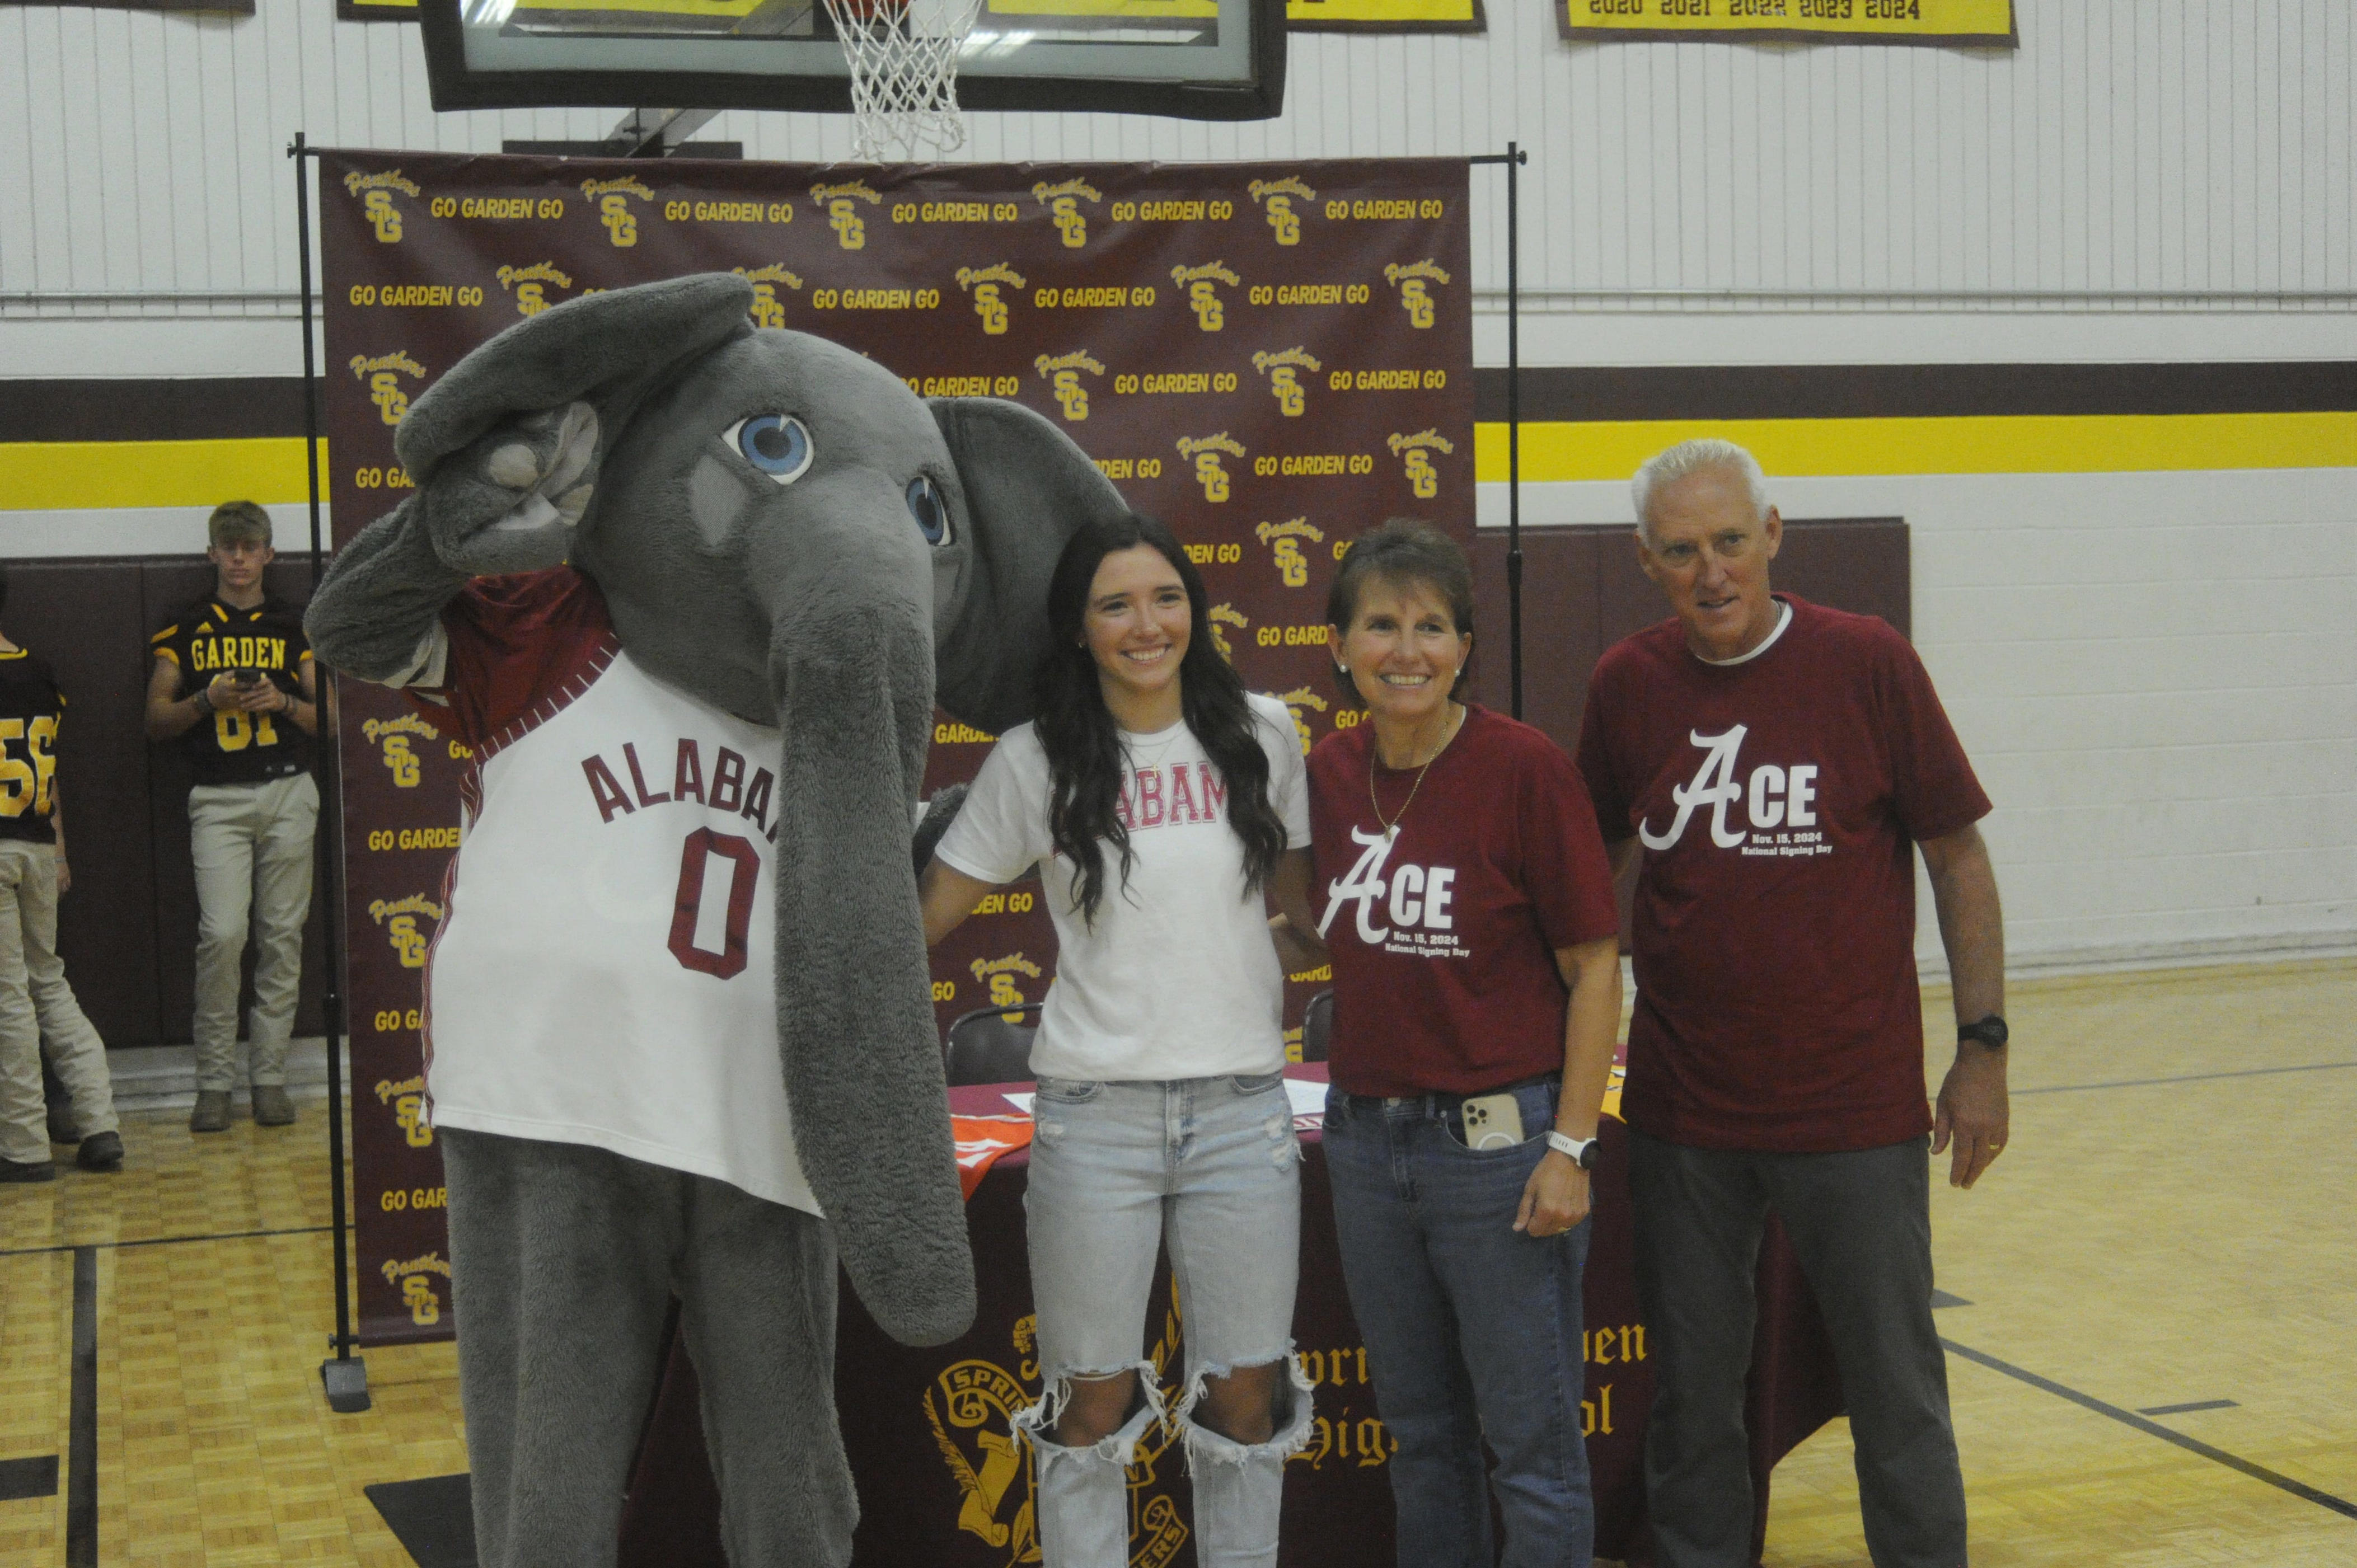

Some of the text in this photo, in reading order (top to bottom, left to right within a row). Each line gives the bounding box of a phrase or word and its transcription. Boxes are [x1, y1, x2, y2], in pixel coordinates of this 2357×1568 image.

[1800, 0, 1853, 19] 2023
[1866, 0, 1920, 20] 2024
[366, 191, 401, 242] SG
[430, 197, 564, 219] GO GARDEN GO
[665, 200, 793, 224] GO GARDEN GO
[892, 202, 1018, 223] GO GARDEN GO
[1112, 201, 1233, 222] GO GARDEN GO
[1325, 199, 1443, 219] GO GARDEN GO
[602, 196, 636, 246] SG
[830, 200, 864, 250] SG
[1054, 198, 1086, 247] SG
[1267, 196, 1300, 245] SG
[349, 285, 484, 307] GO GARDEN GO
[813, 288, 940, 309] GO GARDEN GO
[1035, 287, 1156, 308] GO GARDEN GO
[1249, 284, 1370, 306] GO GARDEN GO
[1402, 280, 1435, 328] SG
[976, 285, 1008, 334] SG
[1191, 282, 1223, 331] SG
[924, 377, 990, 397] GARDEN
[994, 376, 1019, 396] GO
[1114, 373, 1238, 394] GO GARDEN GO
[1329, 369, 1446, 390] GO GARDEN GO
[372, 374, 407, 424] SG
[1055, 372, 1088, 420] SG
[1273, 368, 1304, 416] SG
[1093, 458, 1162, 479] DEN GO
[1254, 454, 1374, 476] GO GARDEN GO
[1406, 450, 1436, 497] SG
[355, 467, 383, 489] GO
[1197, 454, 1229, 502] SG
[1217, 543, 1241, 564] GO
[1333, 541, 1353, 560] G
[1275, 538, 1307, 586] SG
[1257, 626, 1328, 646] GO GARD
[191, 637, 285, 670] GARDEN
[1336, 710, 1358, 729] GO
[384, 736, 420, 786] SG
[581, 738, 779, 844] ALABA
[1115, 760, 1230, 833] ABAM
[1639, 724, 1817, 851] ACE
[368, 828, 462, 851] GO GARDE
[1752, 832, 1822, 844] Nov. 15, 2024
[1741, 844, 1833, 857] National Signing Day
[1316, 825, 1455, 944] ACE
[1009, 892, 1033, 913] GO
[391, 917, 425, 967] SG
[1393, 931, 1459, 945] Nov. 15, 2024
[1385, 943, 1470, 957] National Signing Day
[931, 981, 955, 1002] GO
[375, 1010, 401, 1031] GO
[381, 1187, 448, 1212] GO GAR
[404, 1275, 439, 1324] SG
